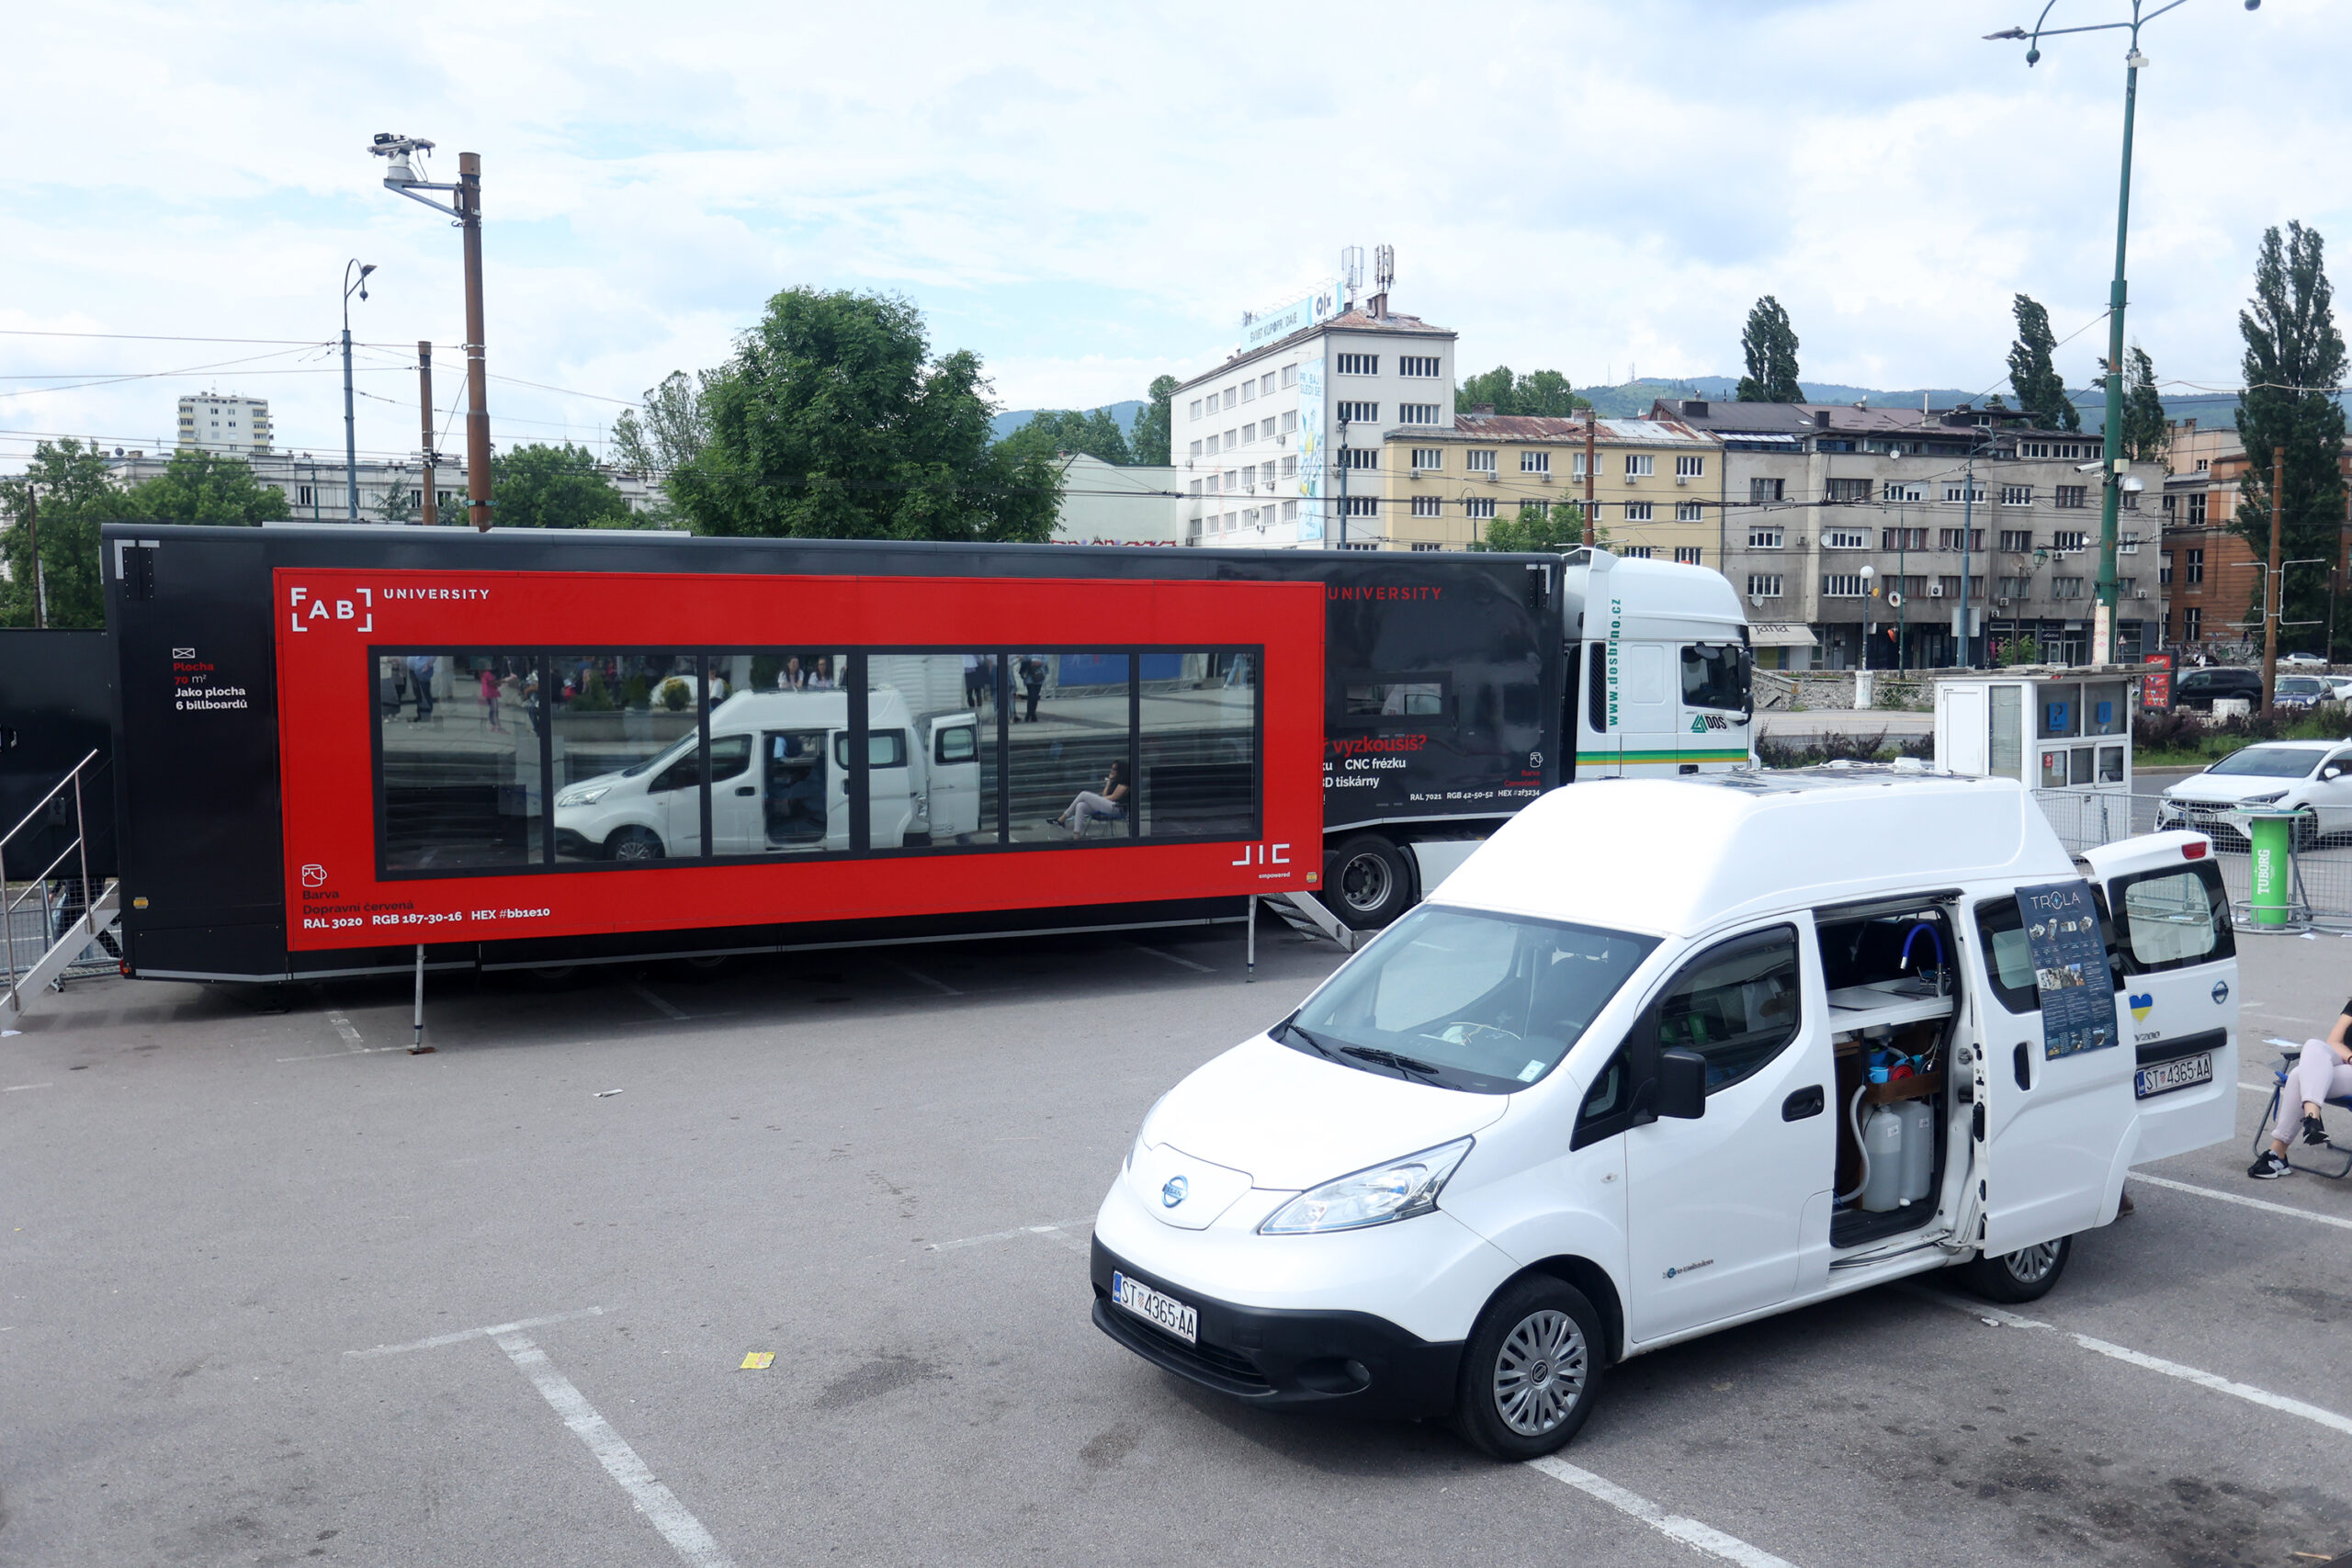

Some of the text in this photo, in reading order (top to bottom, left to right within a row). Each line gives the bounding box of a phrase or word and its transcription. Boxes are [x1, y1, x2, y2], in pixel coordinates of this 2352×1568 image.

[383, 588, 491, 600] UNIVERSITY
[1328, 586, 1442, 601] UNIVERSITY
[290, 587, 356, 621] FAB
[173, 662, 215, 671] Plocha
[1607, 599, 1622, 727] www.dosbrno.cz
[174, 676, 189, 686] 70
[175, 686, 246, 698] Jako plocha
[175, 699, 248, 710] 6 billboardů
[1704, 716, 1727, 729] DOS
[1344, 759, 1370, 770] CNC
[1372, 758, 1407, 769] frézku
[1336, 775, 1380, 789] tiskárny
[1463, 791, 1494, 800] 42-50-52
[1498, 789, 1512, 797] HEX
[2256, 849, 2271, 896] TUBORG
[302, 890, 340, 899] Barva
[2030, 891, 2081, 910] TROLA
[303, 900, 413, 915] Dopravní červená
[303, 908, 550, 929] RAL 3020 RGB 187-30-16 HEX #bb1e10
[2145, 1070, 2158, 1089] ST
[1122, 1280, 1136, 1306] ST
